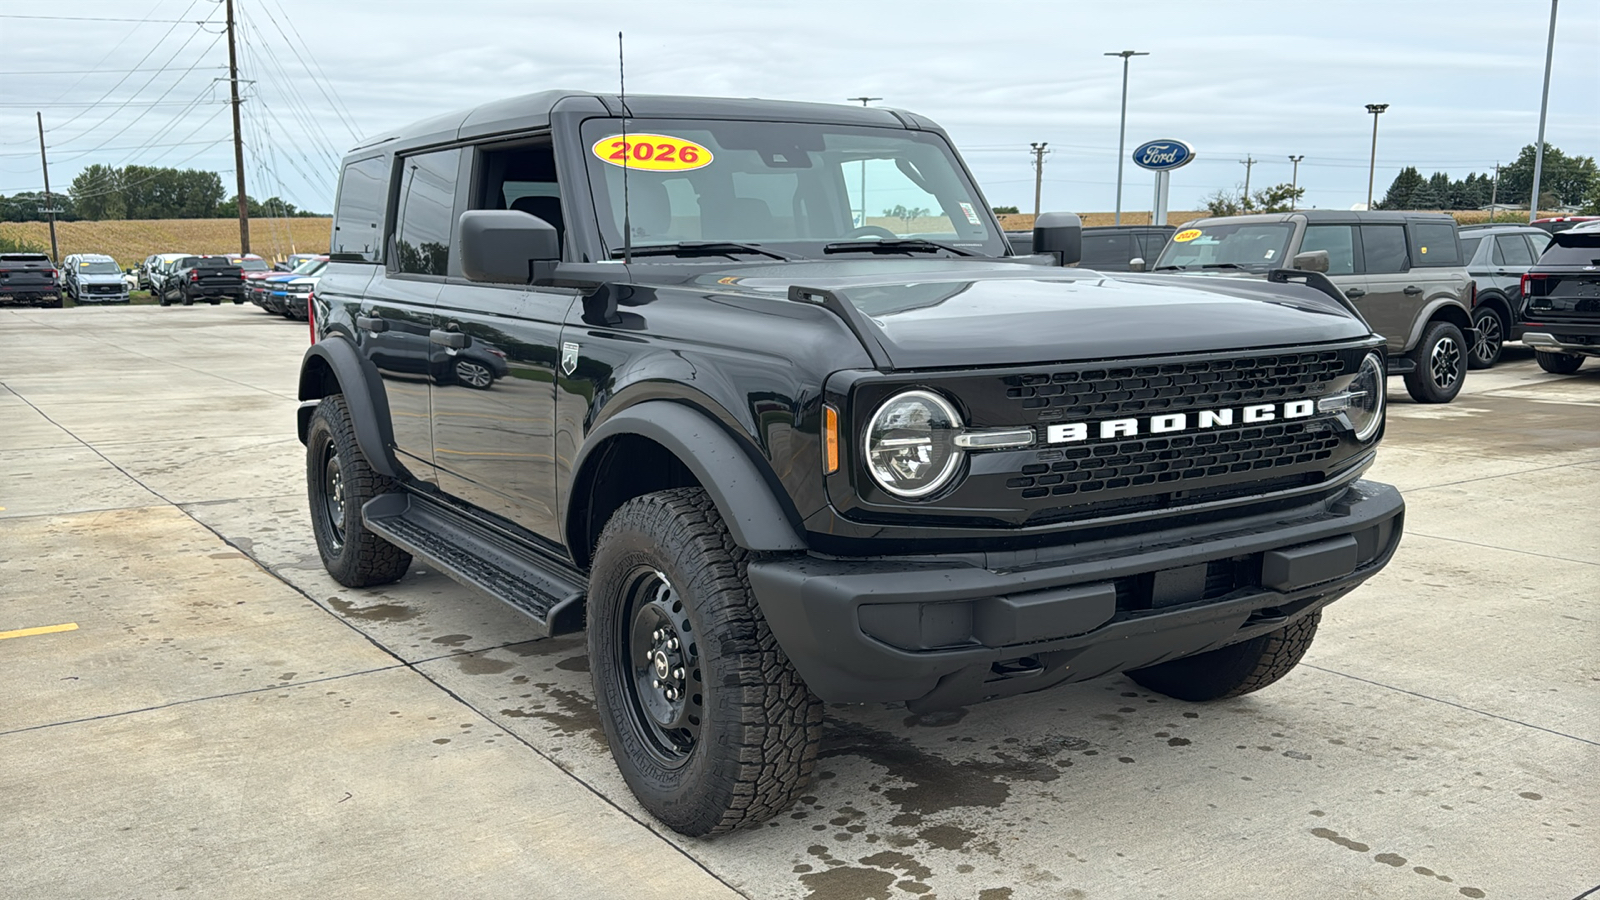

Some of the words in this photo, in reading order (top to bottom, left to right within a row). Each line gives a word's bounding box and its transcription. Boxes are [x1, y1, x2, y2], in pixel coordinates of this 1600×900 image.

[609, 141, 700, 164] 2026
[1142, 145, 1178, 164] Ford
[1047, 400, 1314, 443] BRONCO
